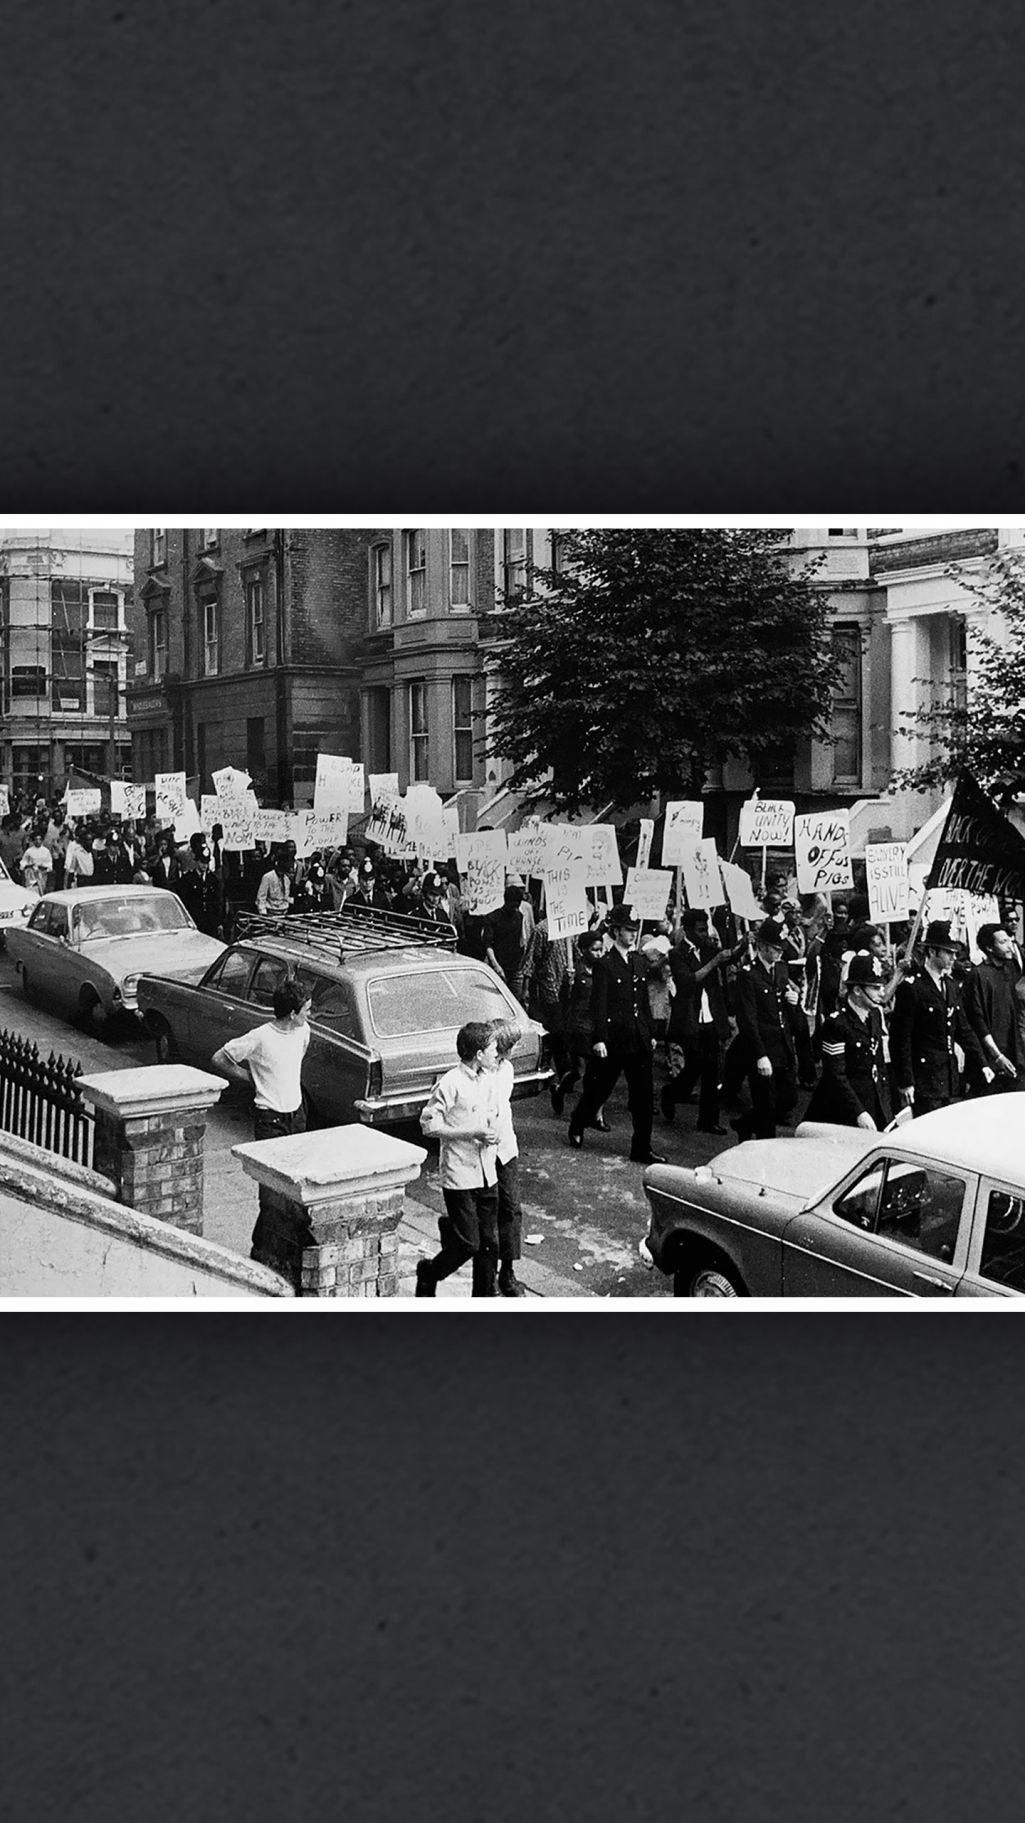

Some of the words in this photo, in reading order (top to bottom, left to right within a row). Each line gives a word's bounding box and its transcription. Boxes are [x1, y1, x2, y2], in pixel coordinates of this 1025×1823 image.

[755, 801, 784, 813] BLACK
[305, 812, 342, 826] POWER
[755, 813, 791, 828] UNITY
[307, 825, 317, 834] TO
[320, 824, 335, 834] THE
[749, 826, 790, 843] NOW!
[798, 818, 847, 848] HANDS
[557, 845, 583, 861] PI
[807, 846, 841, 868] OFF
[547, 868, 570, 885] THIS
[813, 869, 850, 888] PIGS
[964, 860, 994, 892] THE
[870, 882, 906, 914] ALIVE
[549, 901, 565, 916] THE
[553, 911, 585, 932] TIME
